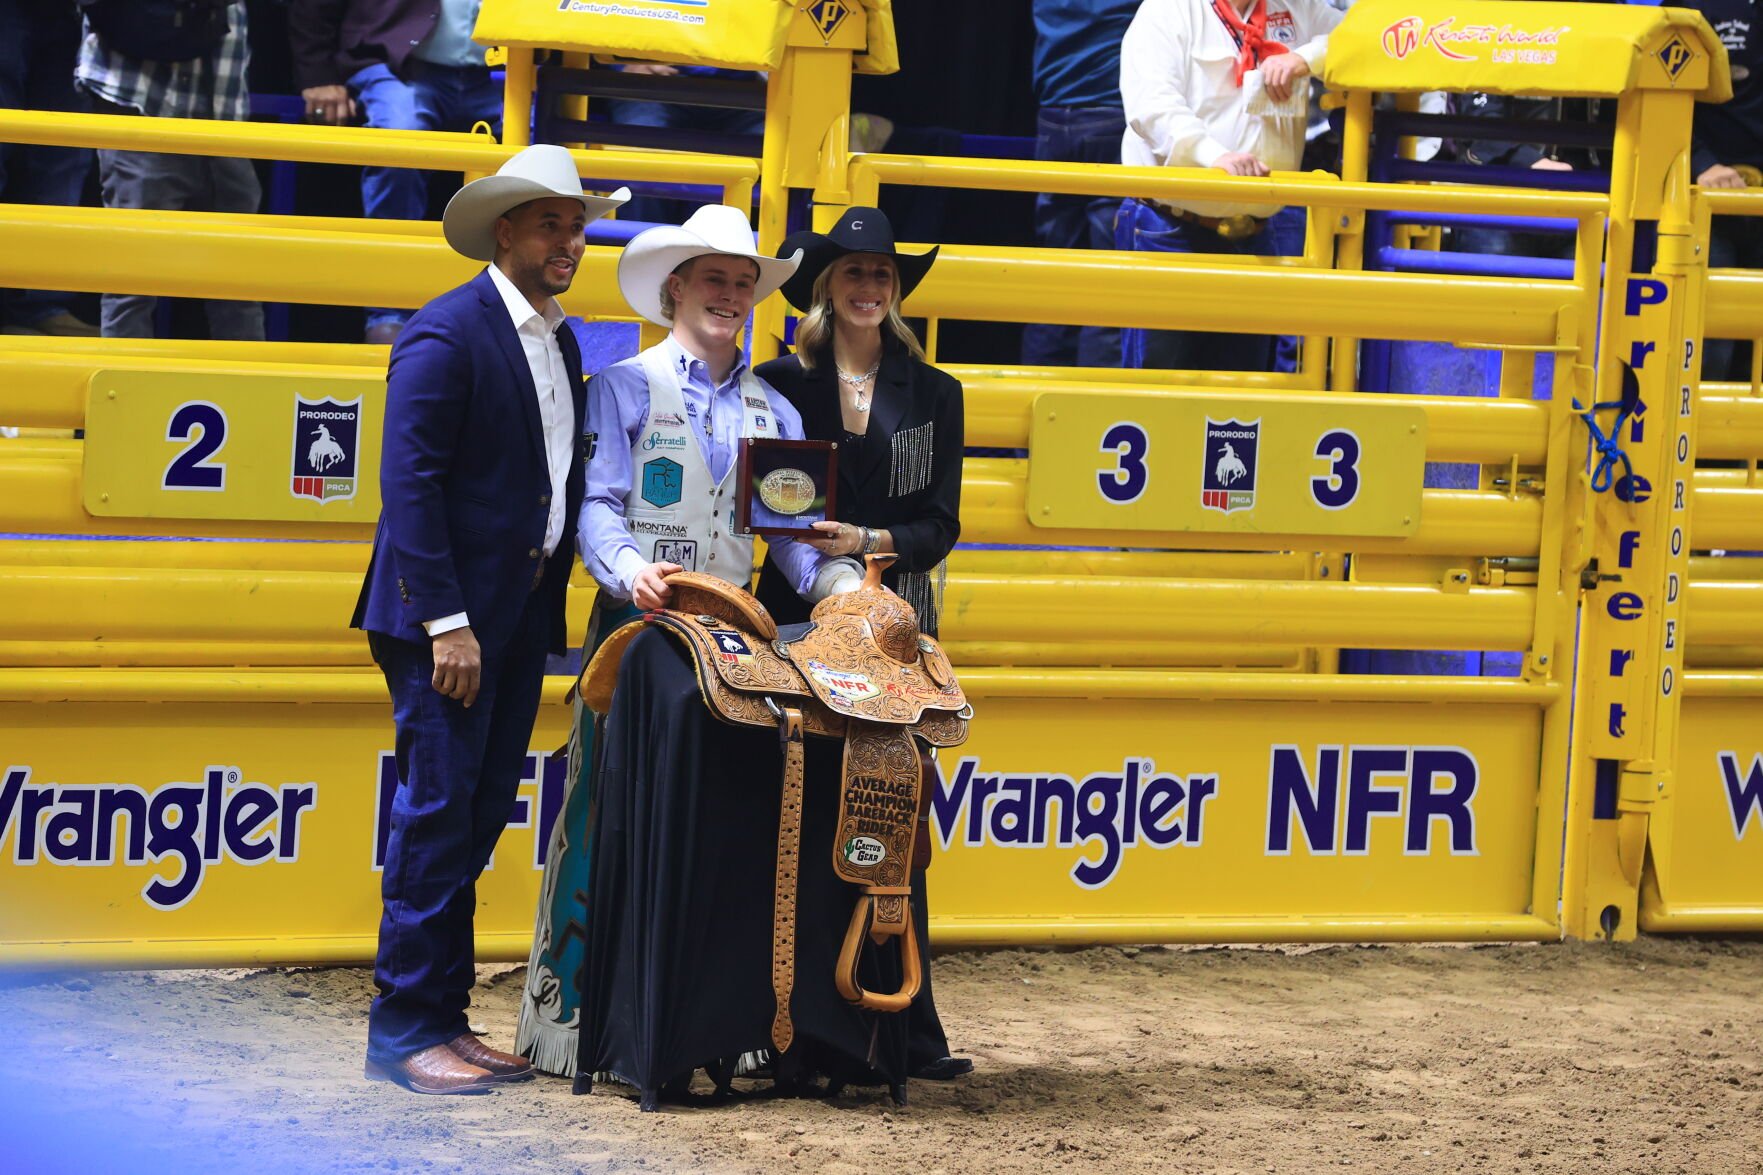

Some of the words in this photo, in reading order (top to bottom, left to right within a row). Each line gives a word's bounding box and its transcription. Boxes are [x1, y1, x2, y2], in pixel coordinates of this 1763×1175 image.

[571, 2, 704, 24] CenturyProductsUSA.com
[1492, 51, 1514, 63] LAS
[1518, 51, 1557, 64] VEGAS
[299, 410, 356, 421] PRORODEO
[642, 431, 686, 451] Serratelli
[1208, 430, 1256, 440] PRORODEO
[164, 402, 227, 490] 2
[1098, 422, 1148, 504] 3
[1311, 429, 1360, 511] 3
[326, 483, 351, 492] PRCA
[636, 521, 688, 534] MONTANA
[1661, 340, 1694, 697] PRORODEO
[659, 544, 670, 559] T
[682, 545, 692, 560] M
[830, 679, 871, 693] NFR
[852, 776, 913, 797] AVERAGE
[845, 789, 916, 813] CHAMPION
[1266, 748, 1478, 853] NFR
[847, 804, 912, 825] BAREBACK
[857, 819, 894, 836] RIDER
